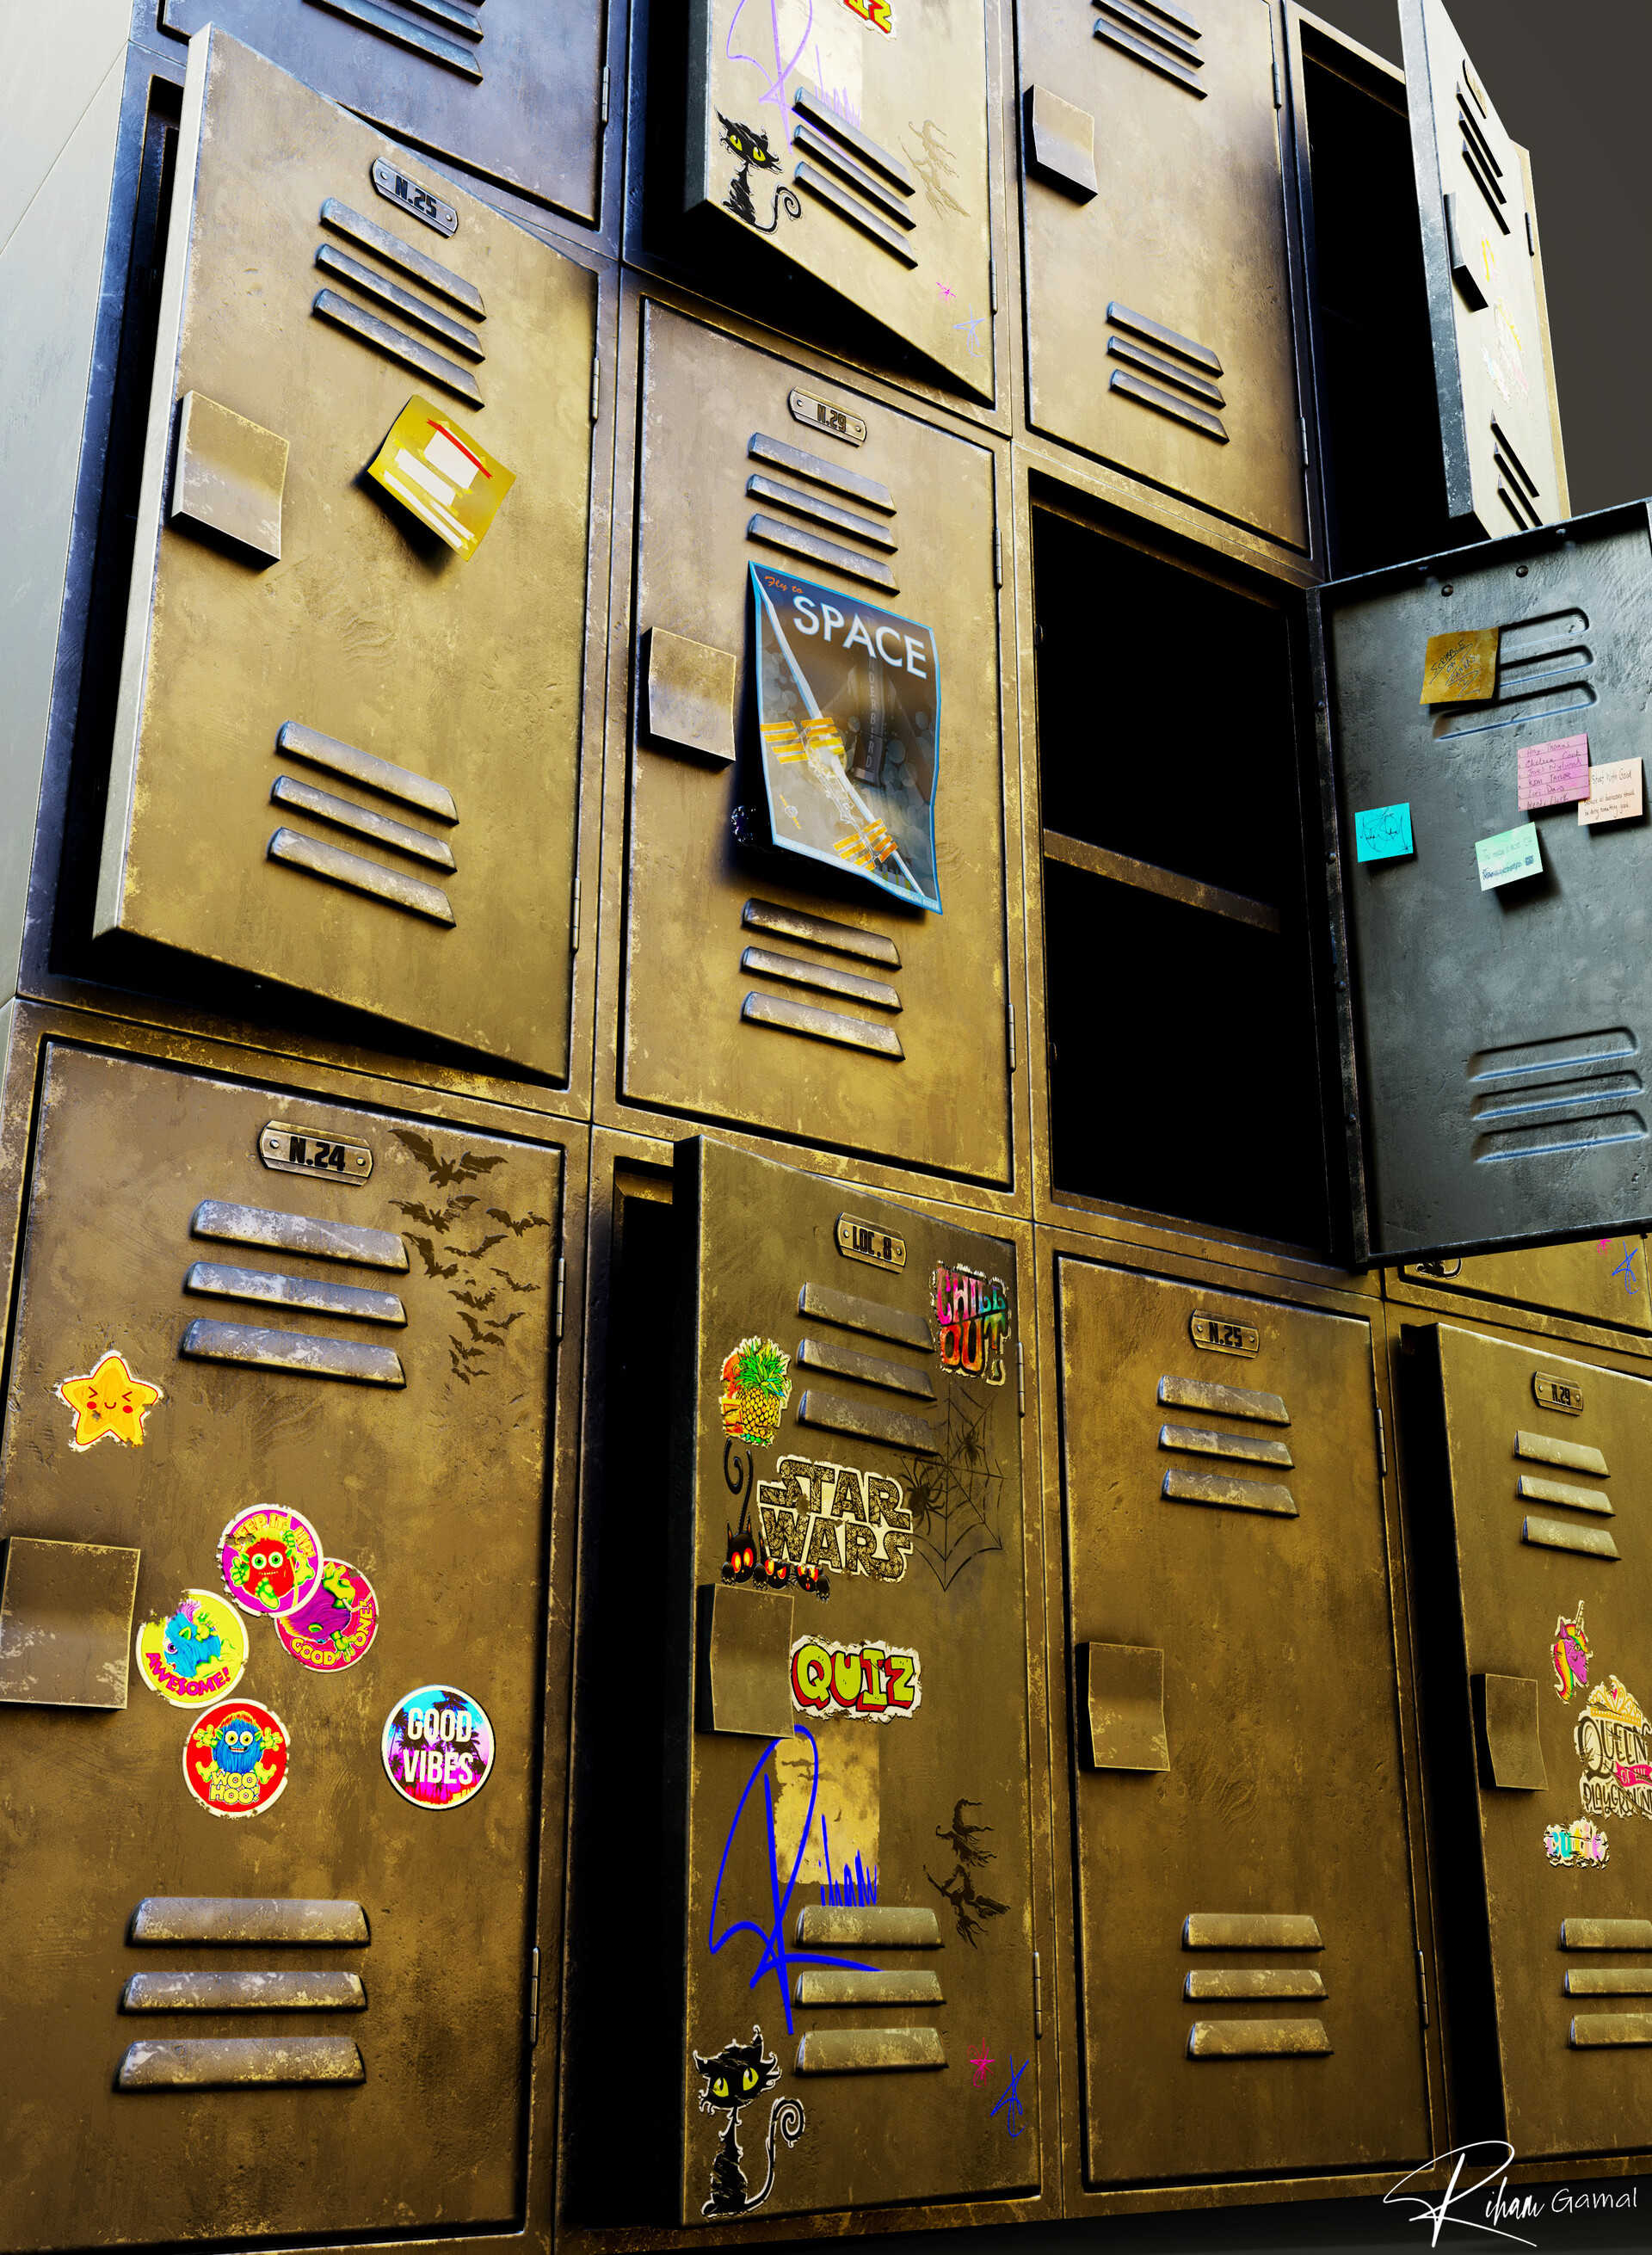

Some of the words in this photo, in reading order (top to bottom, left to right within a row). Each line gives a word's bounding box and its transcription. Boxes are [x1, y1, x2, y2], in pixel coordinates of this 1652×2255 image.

[395, 175, 437, 219] N.25
[817, 404, 847, 433] N.29
[765, 576, 787, 591] Fly
[793, 595, 927, 679] SPACE
[289, 1136, 346, 1172] N.24
[937, 1266, 1007, 1325] CHILL
[940, 1310, 1006, 1376] OUT
[1208, 1321, 1243, 1348] N.25
[1550, 1383, 1571, 1406] N.29
[759, 1458, 912, 1531] STAR
[761, 1506, 913, 1579] WARS
[291, 1637, 336, 1666] GOOD
[145, 1652, 231, 1697] AWESOME!
[791, 1643, 915, 1712] QUIZ
[407, 1707, 472, 1743] GOOD
[403, 1749, 474, 1785] VIBES
[1578, 1716, 1651, 1782] QUEEN
[210, 1770, 258, 1789] WOO
[1547, 1824, 1605, 1860] cutie
